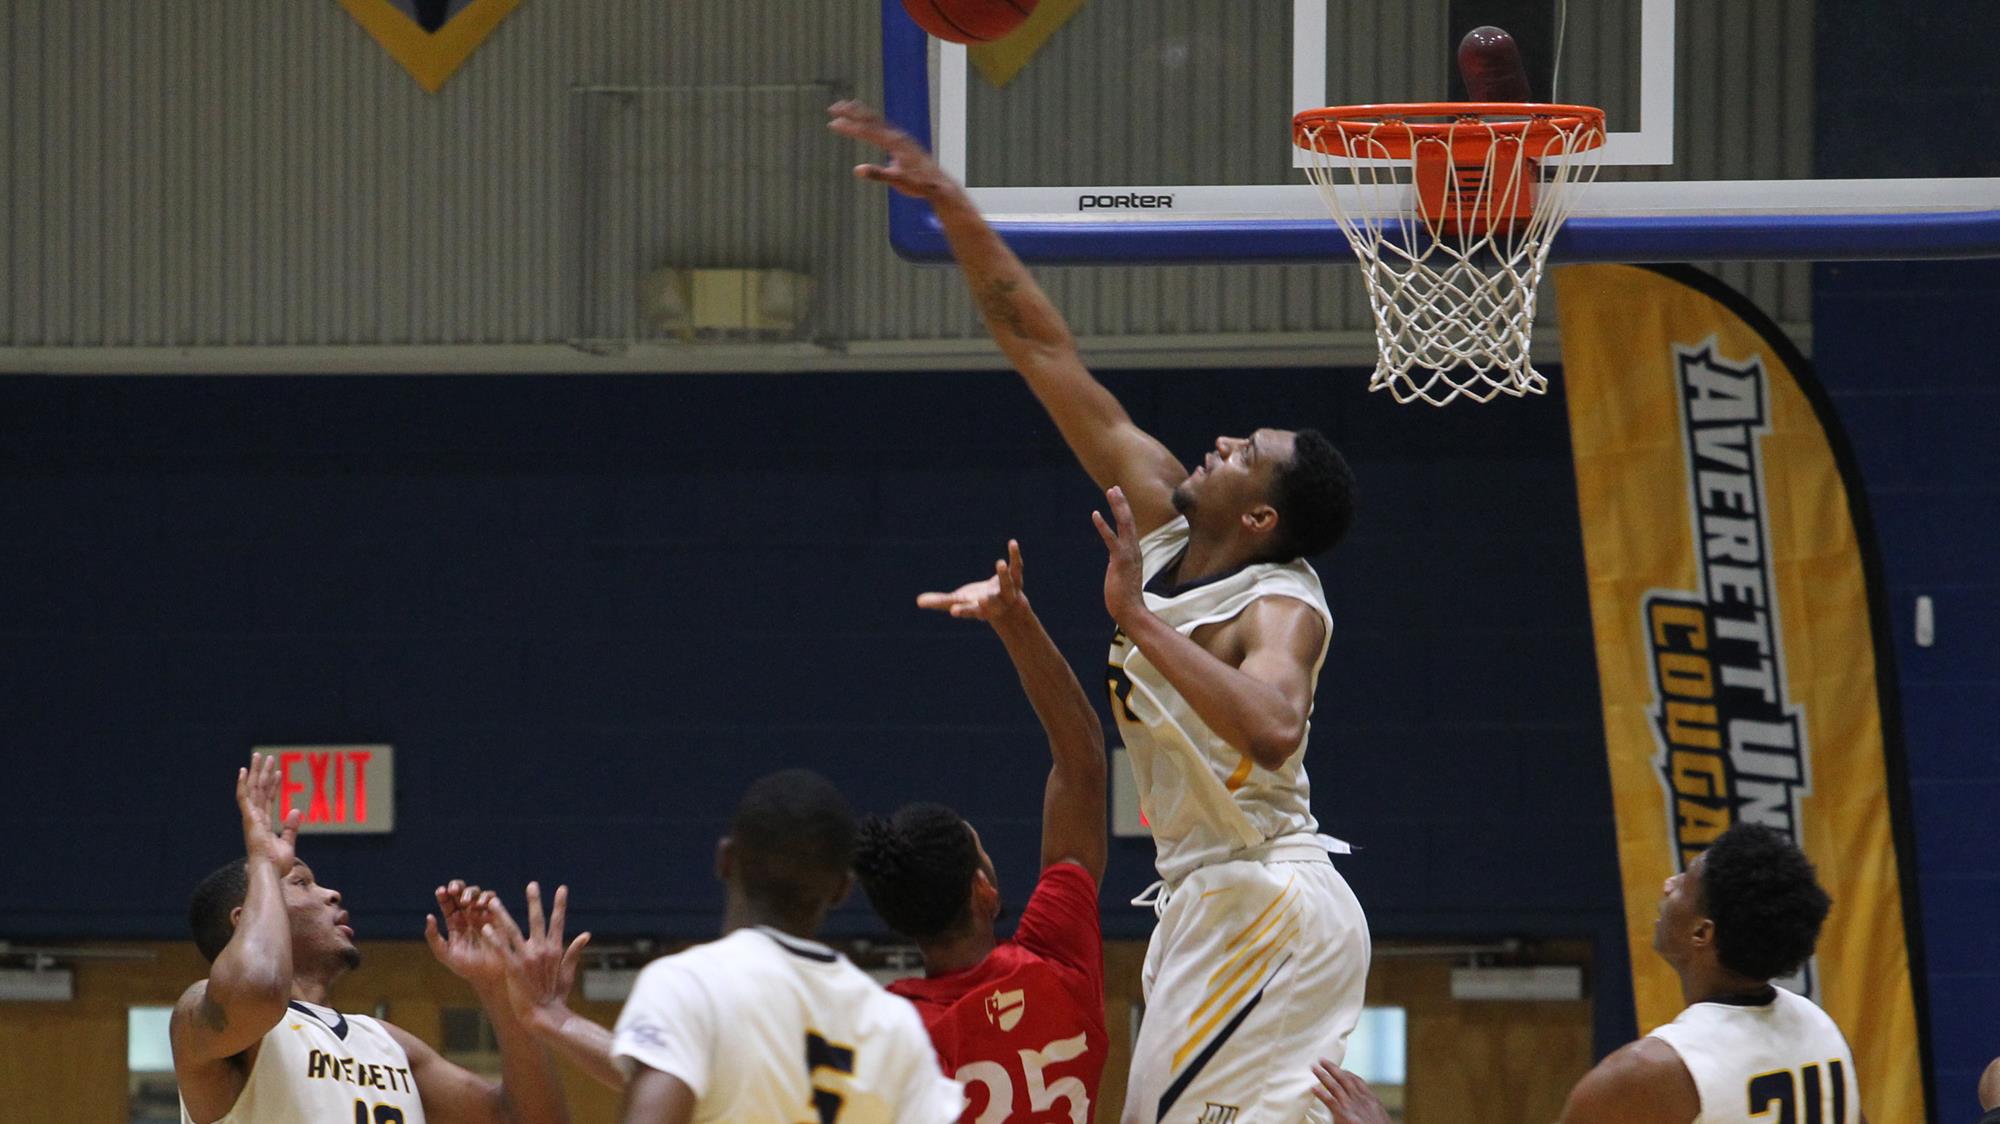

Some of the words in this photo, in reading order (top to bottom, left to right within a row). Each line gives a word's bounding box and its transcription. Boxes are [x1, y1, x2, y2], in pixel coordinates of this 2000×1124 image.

[1682, 353, 1778, 704] AVERETT
[279, 752, 372, 824] EXIT
[1727, 718, 1801, 831] UN
